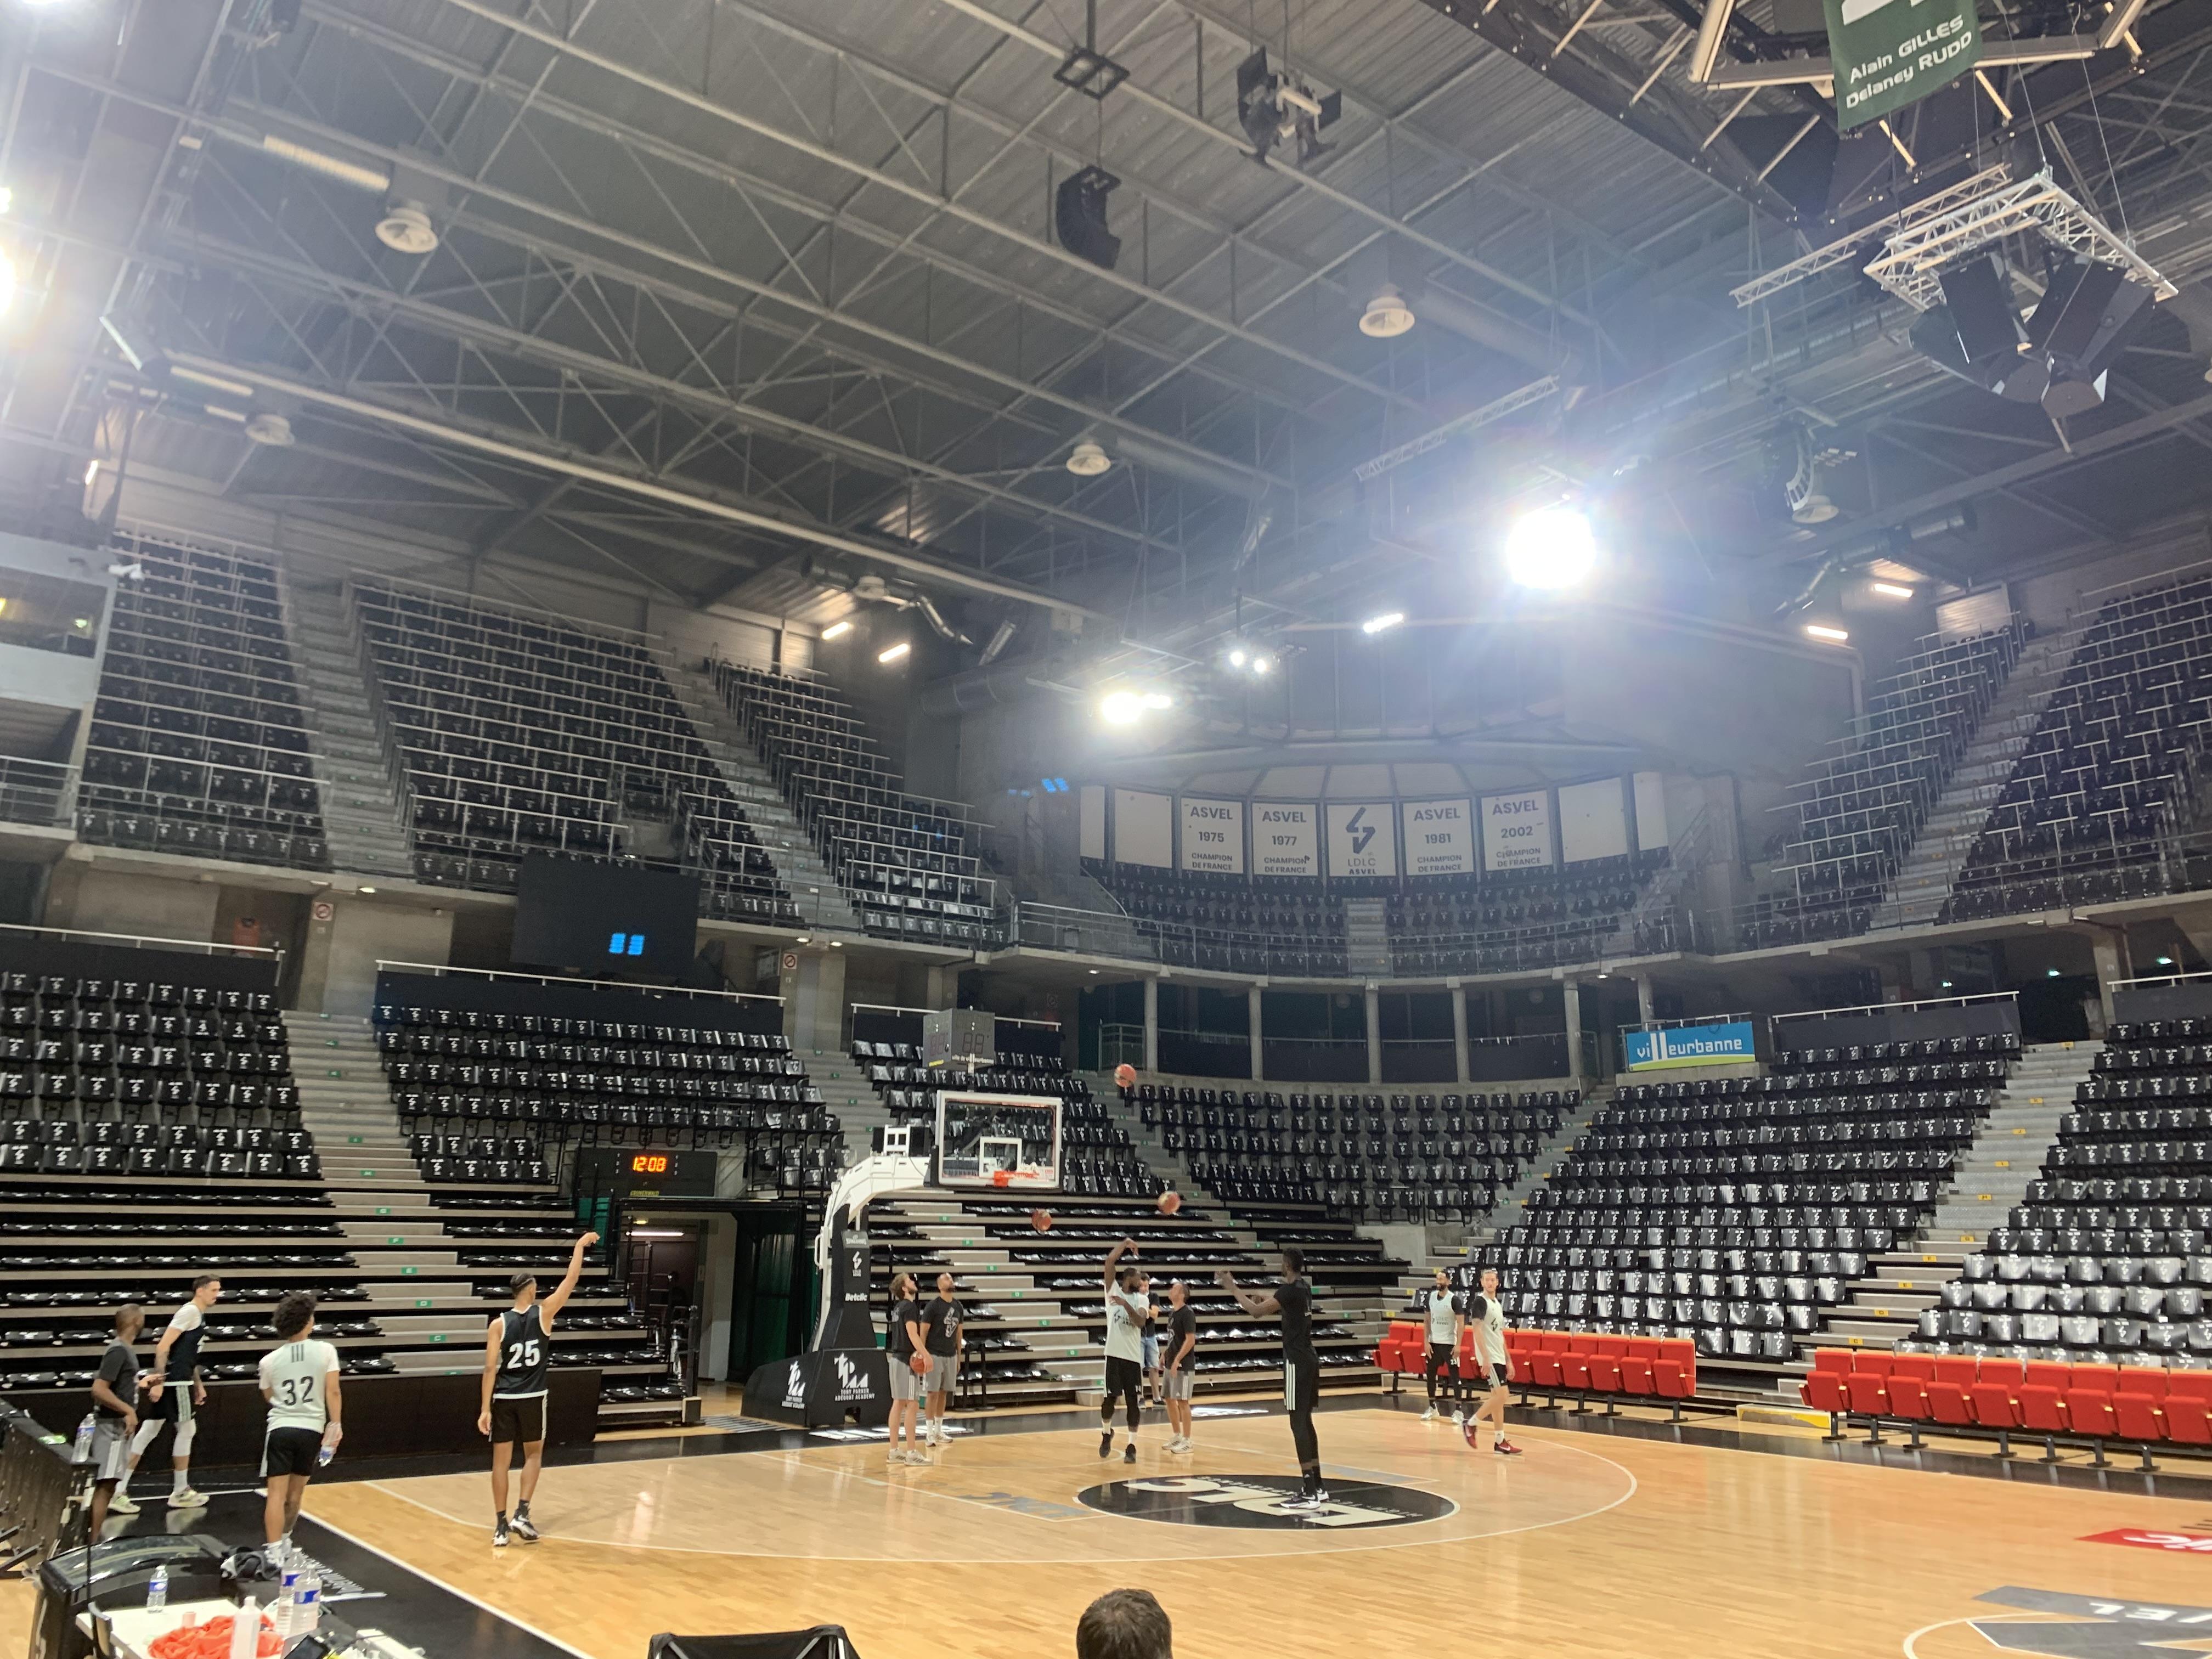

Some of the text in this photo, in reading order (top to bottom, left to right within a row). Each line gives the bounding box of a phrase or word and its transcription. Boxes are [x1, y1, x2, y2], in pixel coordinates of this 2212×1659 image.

[1850, 14, 1964, 84] Alain GILLES
[1847, 31, 1972, 109] Delaney RUDD
[1190, 806, 1233, 820] ASVEL
[1492, 799, 1538, 816] ASVEL
[1262, 811, 1306, 823] ASVEL
[1414, 808, 1460, 821] ASVEL
[1199, 831, 1224, 843] 1975
[1500, 826, 1533, 839] 2002
[1272, 836, 1297, 846] 1977
[1425, 833, 1451, 844] 1981
[1192, 853, 1233, 862] CHAMPION
[1417, 854, 1462, 864] CHAMPION
[1496, 848, 1541, 859] CHAMPION
[1264, 856, 1307, 865] CHAMPION
[1348, 858, 1376, 866] LDLC
[1509, 856, 1541, 866] FRANCE
[1203, 862, 1232, 871] FRANCE
[1276, 865, 1306, 873] FRANCE
[1429, 863, 1462, 871] FRANCE
[1637, 1032, 1742, 1061] villeurbanne
[845, 1293, 867, 1301] Betclic
[507, 1339, 540, 1369] 25
[281, 1376, 313, 1406] 32
